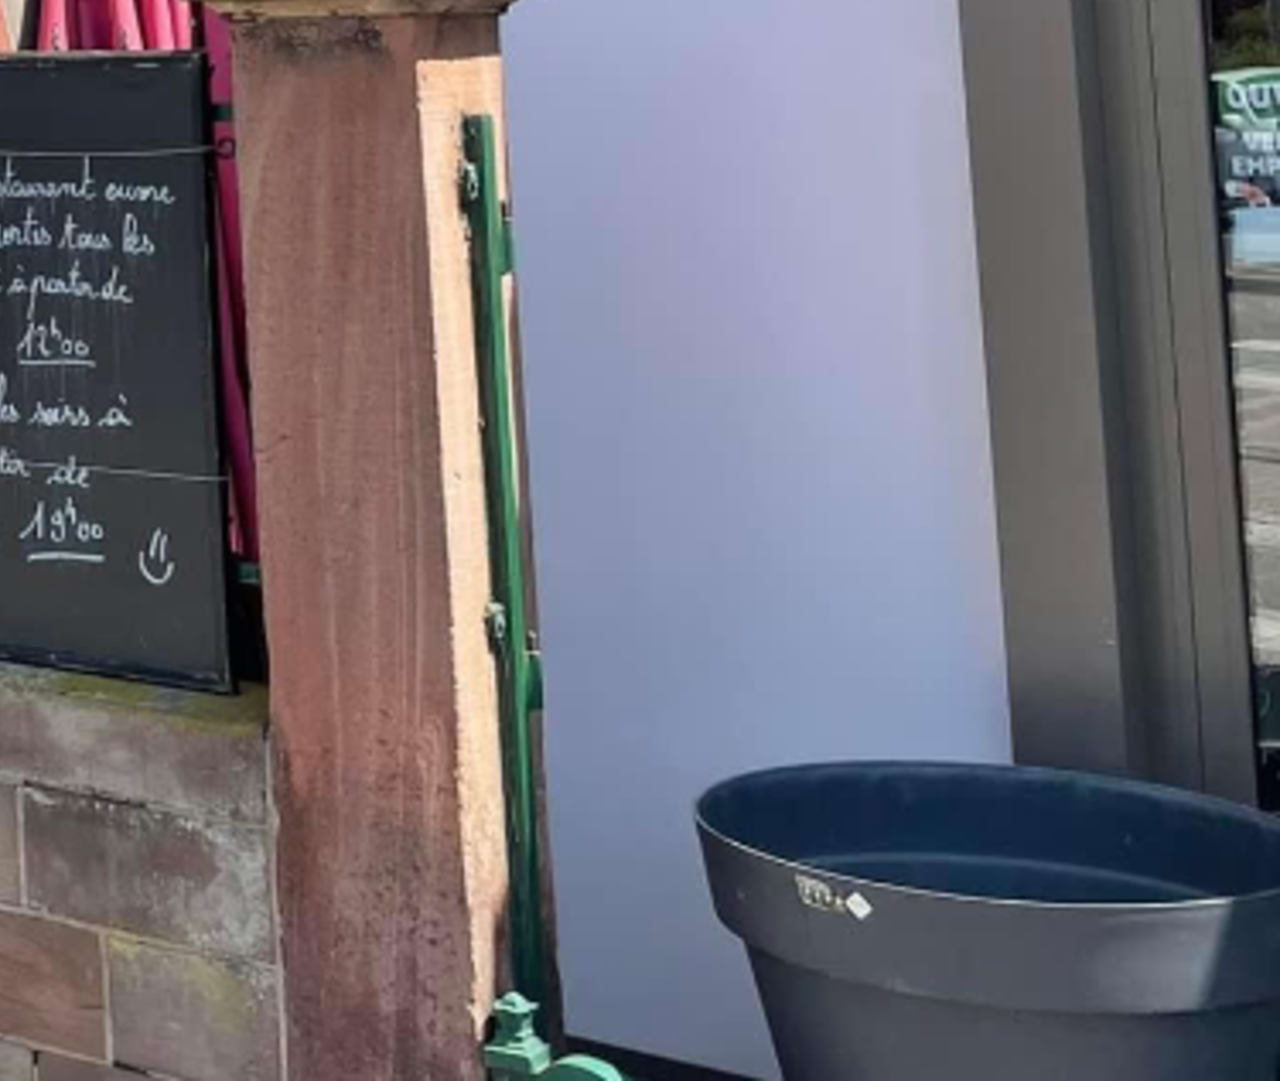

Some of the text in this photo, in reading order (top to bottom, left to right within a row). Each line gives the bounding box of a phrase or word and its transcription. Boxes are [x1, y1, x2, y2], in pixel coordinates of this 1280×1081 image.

[57, 213, 114, 250] tous
[121, 212, 156, 255] les
[7, 264, 28, 296] à
[100, 265, 135, 304] de
[27, 397, 91, 427] soirs
[96, 392, 134, 427] à
[46, 454, 90, 489] de
[18, 496, 105, 543] 19h00
